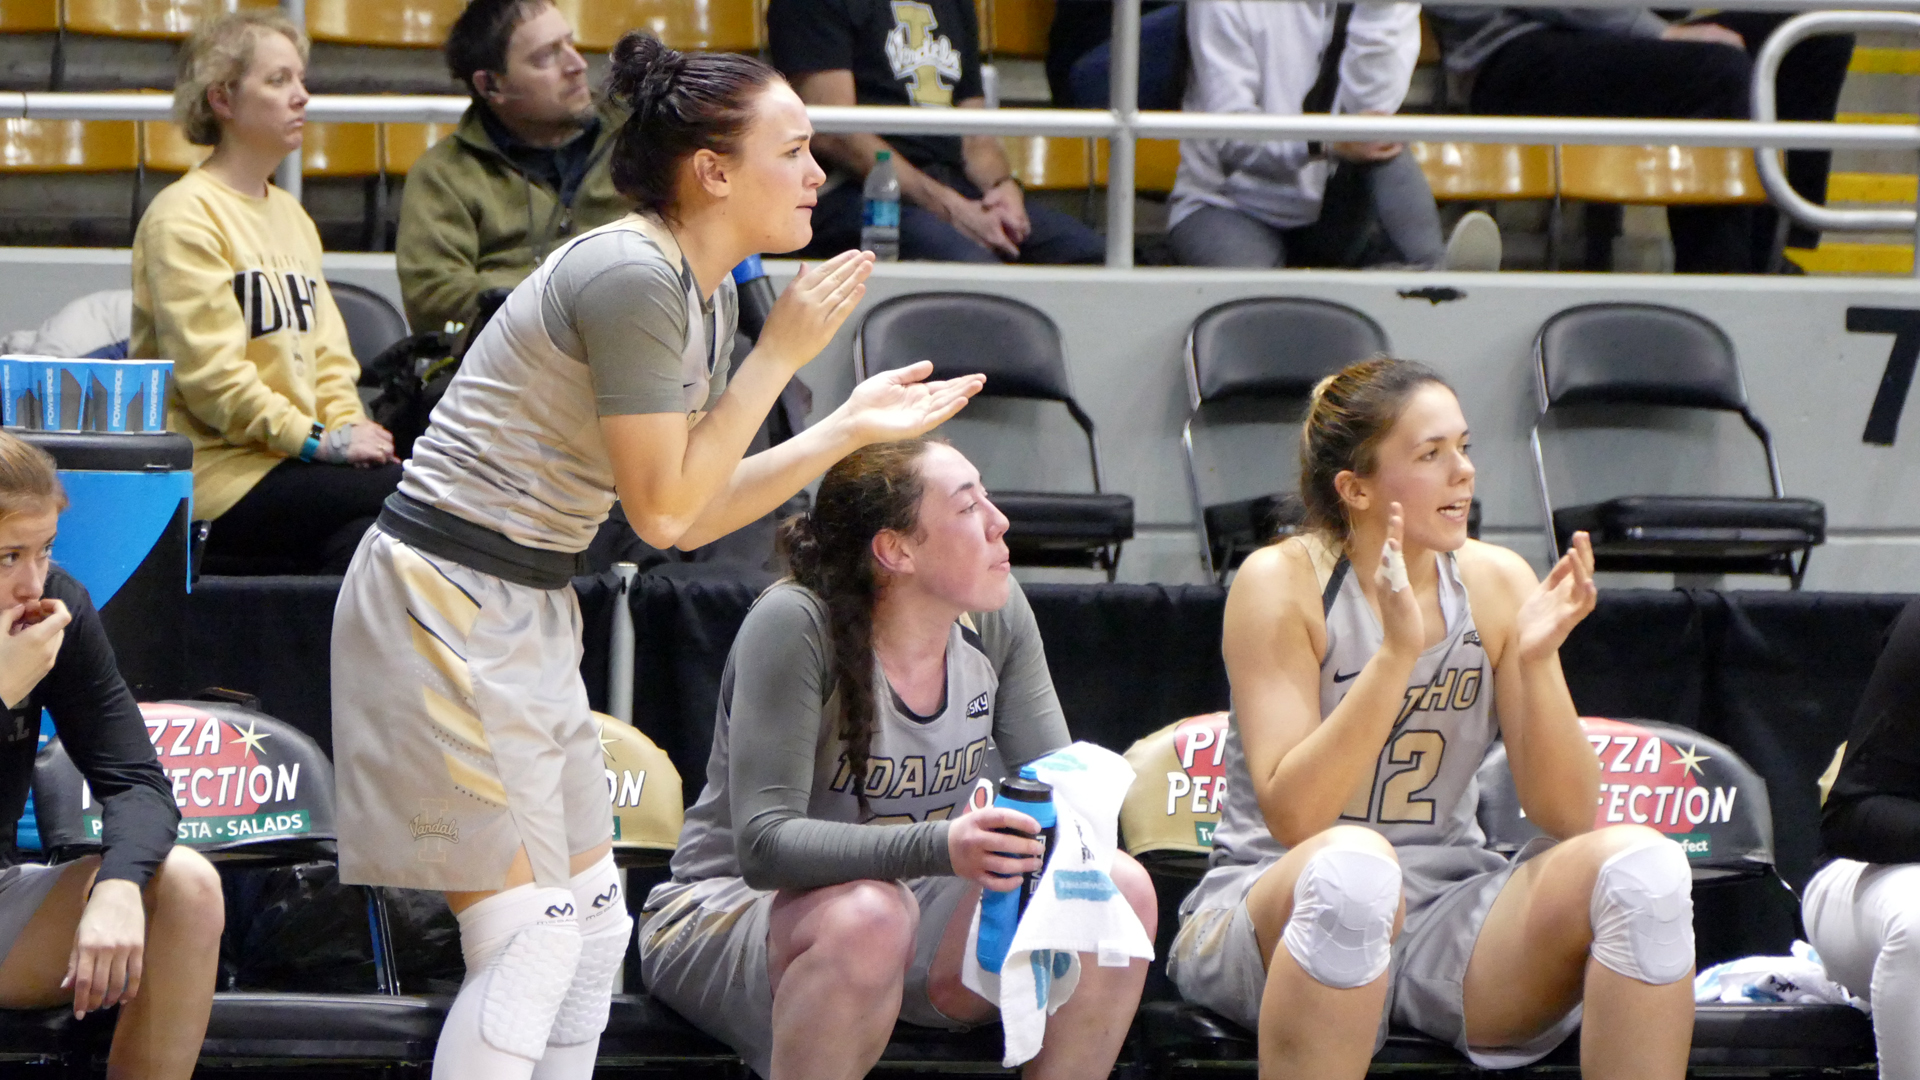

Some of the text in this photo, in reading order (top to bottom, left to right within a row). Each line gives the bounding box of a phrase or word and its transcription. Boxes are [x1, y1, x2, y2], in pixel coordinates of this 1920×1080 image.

[1846, 307, 1920, 446] 7
[144, 717, 221, 757] ZZA
[1586, 734, 1663, 773] ZZA
[1597, 783, 1737, 826] ECTION
[177, 813, 303, 839] STA SALADS
[409, 813, 460, 844] Vandals
